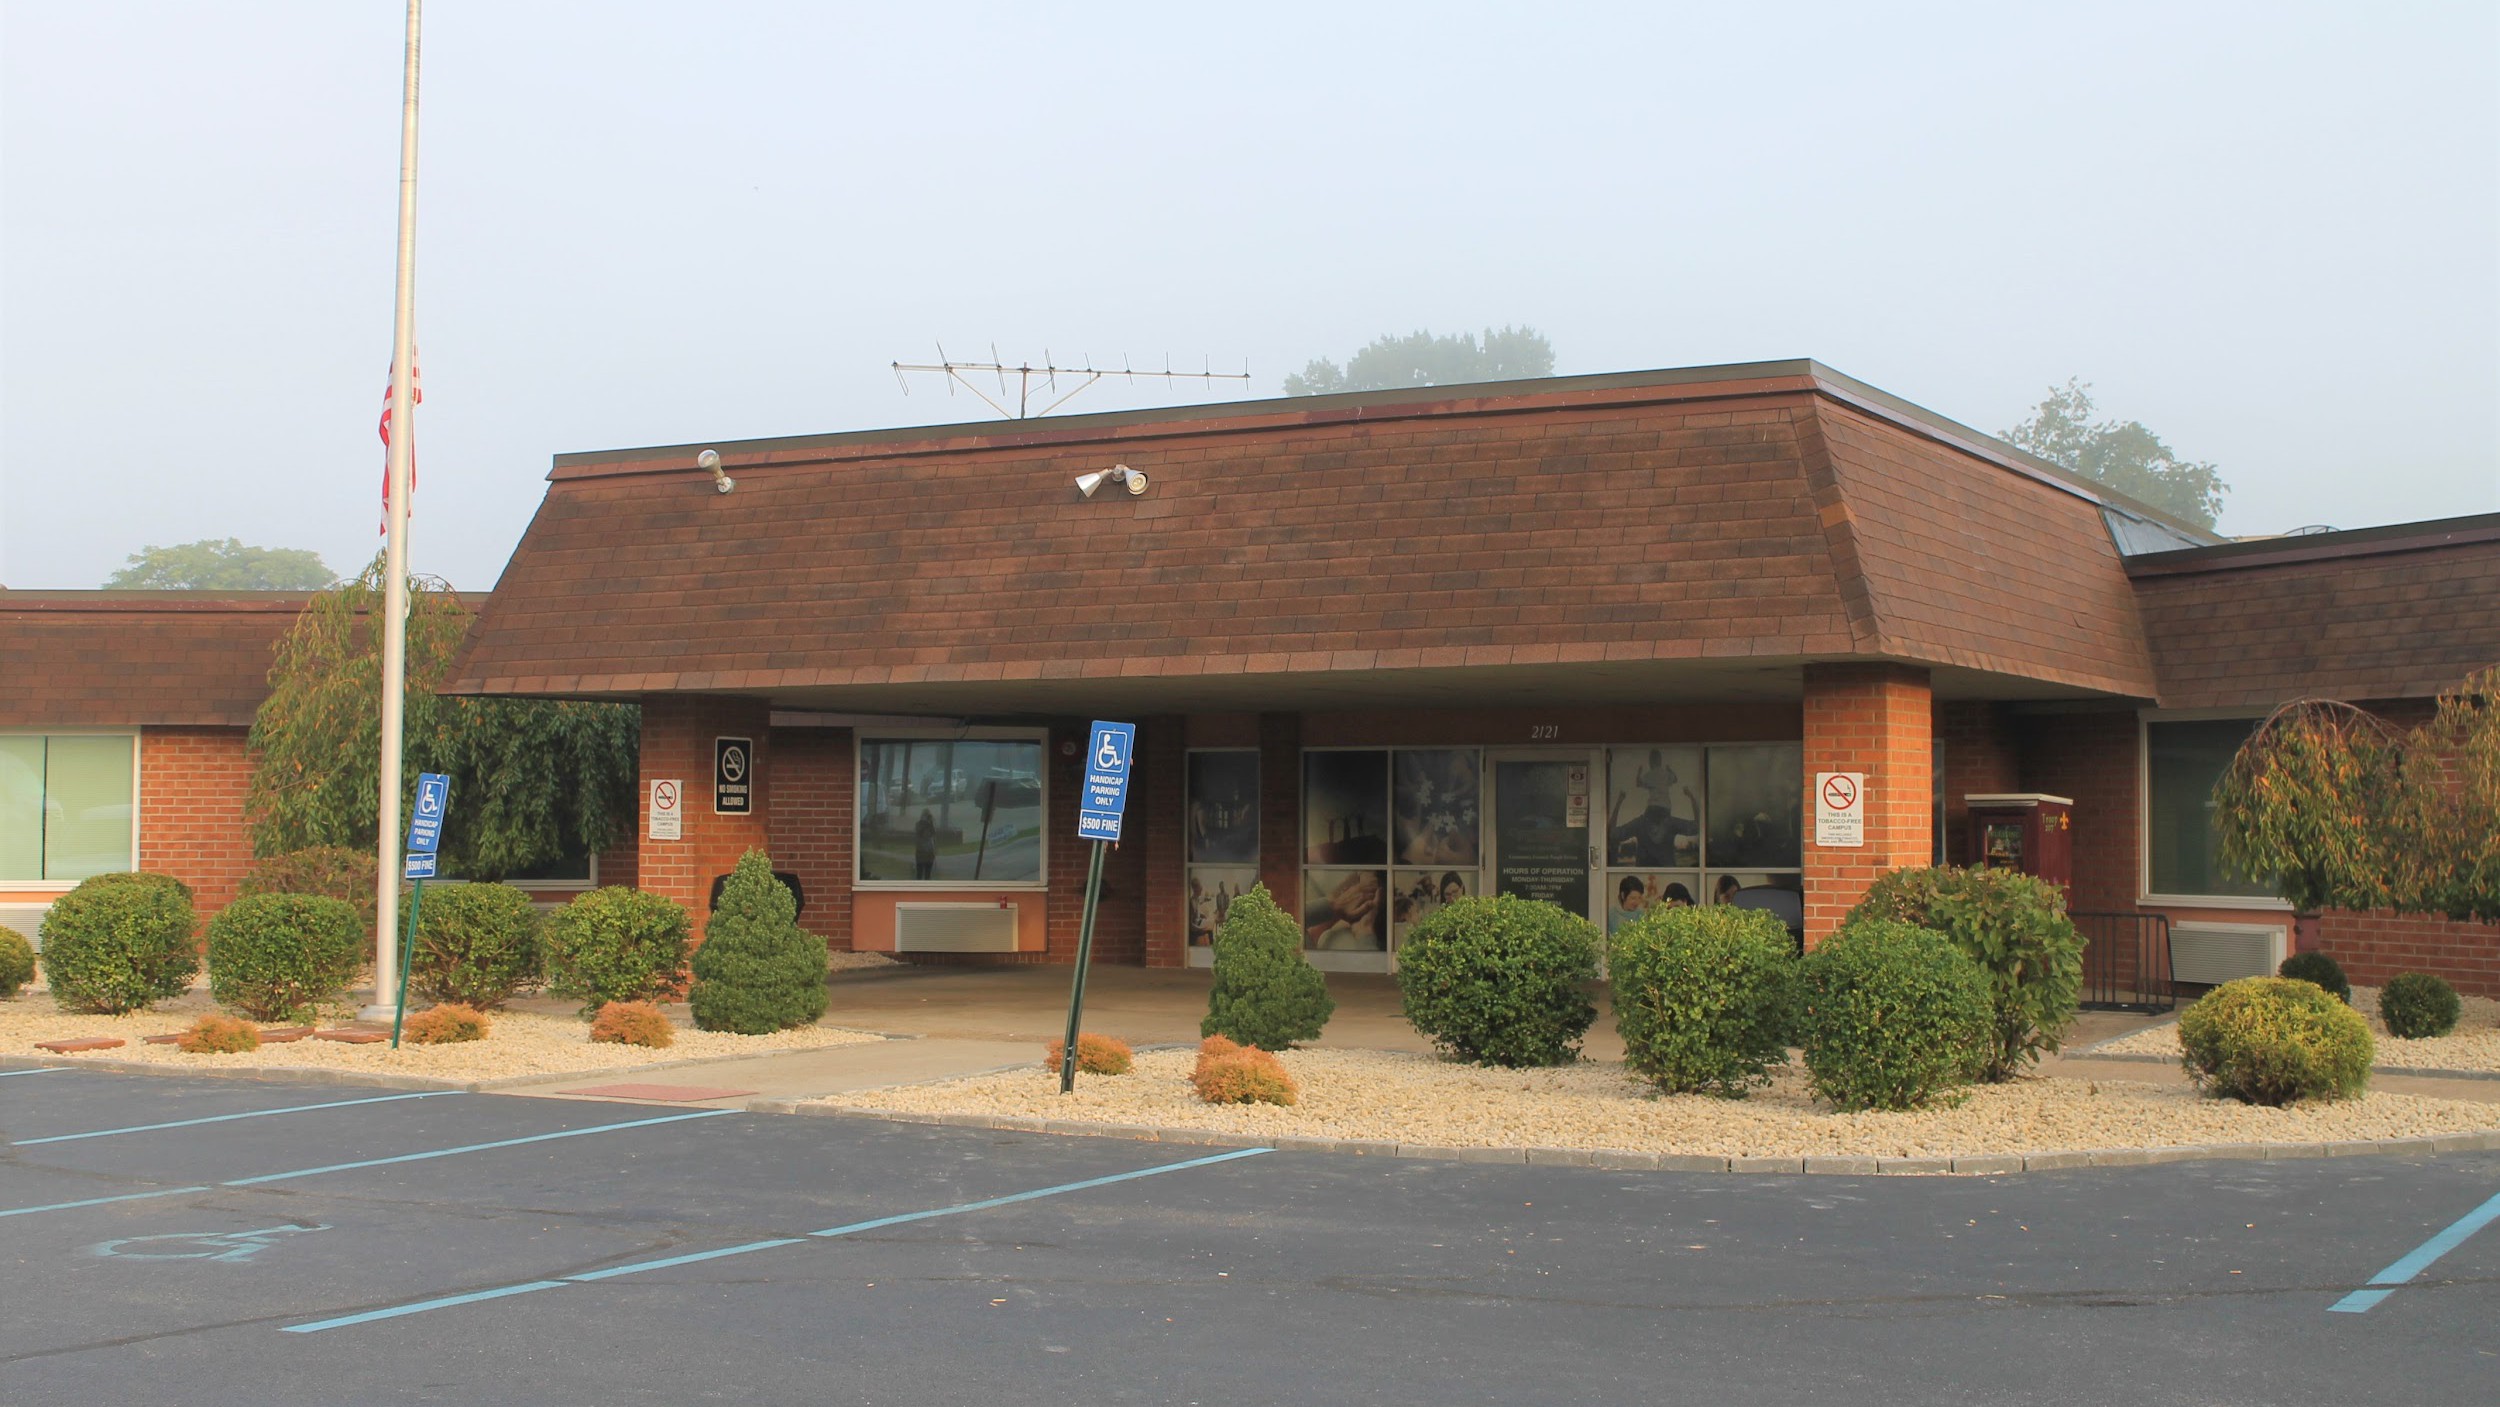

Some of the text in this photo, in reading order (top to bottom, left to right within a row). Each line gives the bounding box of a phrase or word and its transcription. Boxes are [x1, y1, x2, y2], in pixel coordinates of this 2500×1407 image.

[1532, 725, 1558, 738] 2121
[1090, 774, 1123, 786] HANDICAP
[719, 784, 747, 793] NO SMOKING
[1090, 785, 1120, 796] PARKING
[722, 797, 744, 805] ALLOWED
[1095, 796, 1113, 806] ONLY
[415, 819, 438, 828] HANDICAP
[1082, 816, 1118, 832] $500 FINE
[414, 828, 435, 837] PARKING
[416, 837, 430, 846] ONLY
[408, 860, 433, 871] $500 FINE
[1503, 867, 1529, 875] HOURS
[1541, 868, 1584, 876] OPERATION
